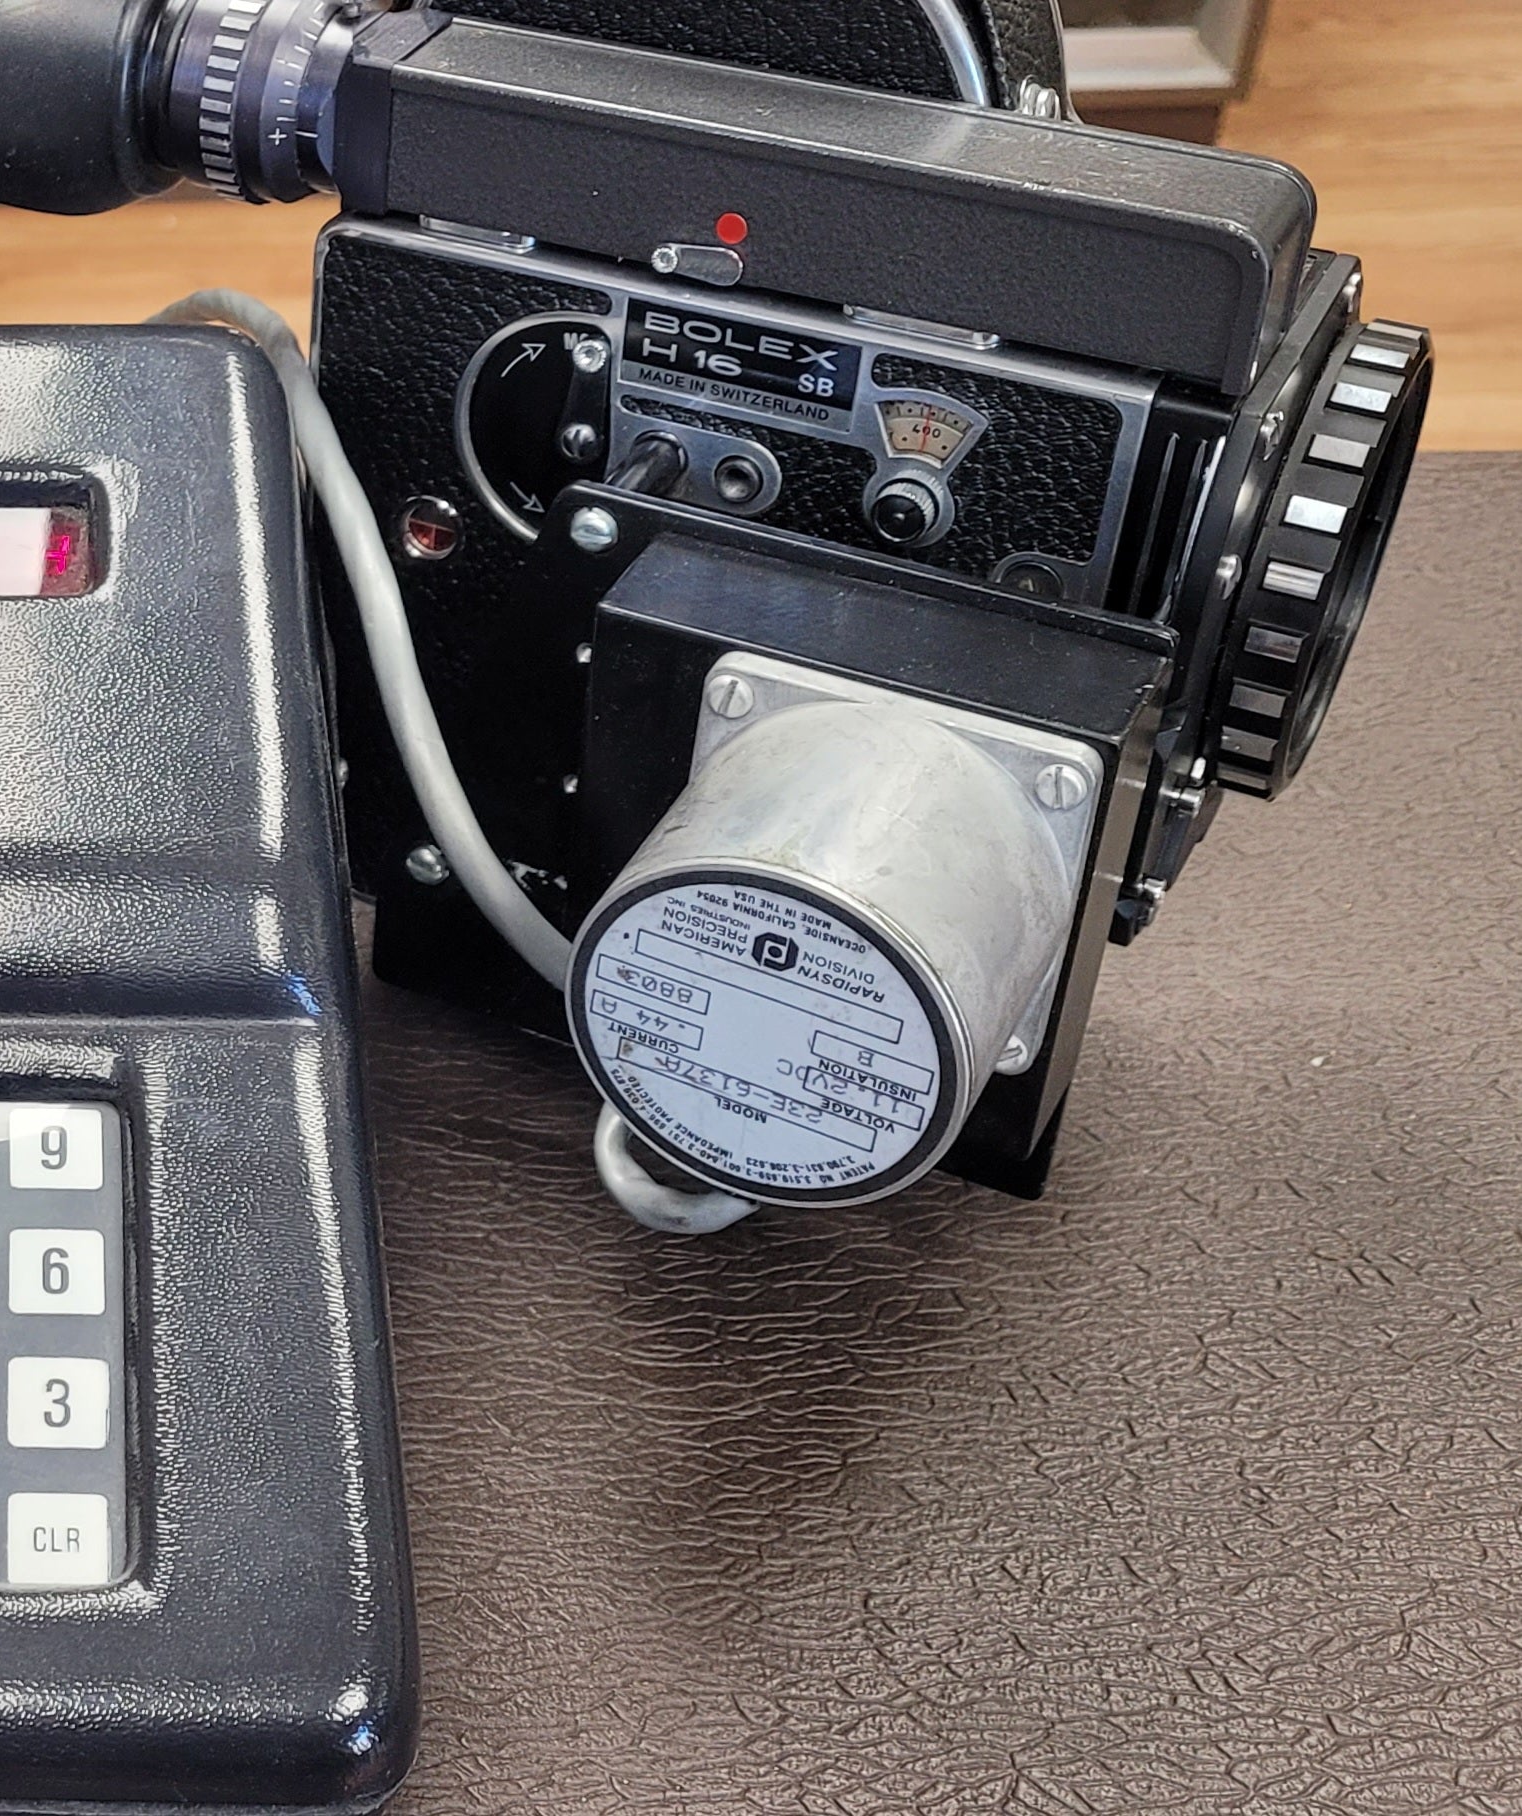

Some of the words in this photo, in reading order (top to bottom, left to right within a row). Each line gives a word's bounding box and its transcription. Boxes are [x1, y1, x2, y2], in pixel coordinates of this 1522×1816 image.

[643, 338, 676, 363] H
[694, 350, 742, 377] 16
[644, 311, 838, 371] BOLEX
[639, 368, 685, 389] MADE
[689, 378, 706, 392] IN
[710, 382, 829, 421] SWITZERLAND
[798, 375, 834, 398] SB
[913, 424, 941, 438] 400
[734, 890, 755, 904] USA
[760, 899, 779, 912] THE
[785, 907, 796, 917] IN
[664, 906, 748, 944] PRECISION
[690, 904, 751, 930] INDUSTRIES
[733, 902, 796, 930] CALIFORNIA
[801, 912, 831, 930] MADE
[661, 919, 747, 957] AMERICAN
[798, 966, 885, 1003] RAPIDSYN
[803, 951, 875, 985] DIVISION
[602, 997, 617, 1014] A
[608, 1022, 679, 1054] CURRENT
[857, 1050, 874, 1068] B
[819, 1059, 917, 1102] INSULATION
[627, 1075, 674, 1123] PROTECTED
[714, 1095, 767, 1124] MODEL
[820, 1098, 895, 1134] VOLTAGE
[41, 1126, 67, 1170] 9
[674, 1122, 733, 1159] IMPEDANCE
[839, 1161, 876, 1181] PATENT
[42, 1249, 69, 1293] 6
[43, 1379, 71, 1427] 3
[33, 1527, 79, 1552] CLR
